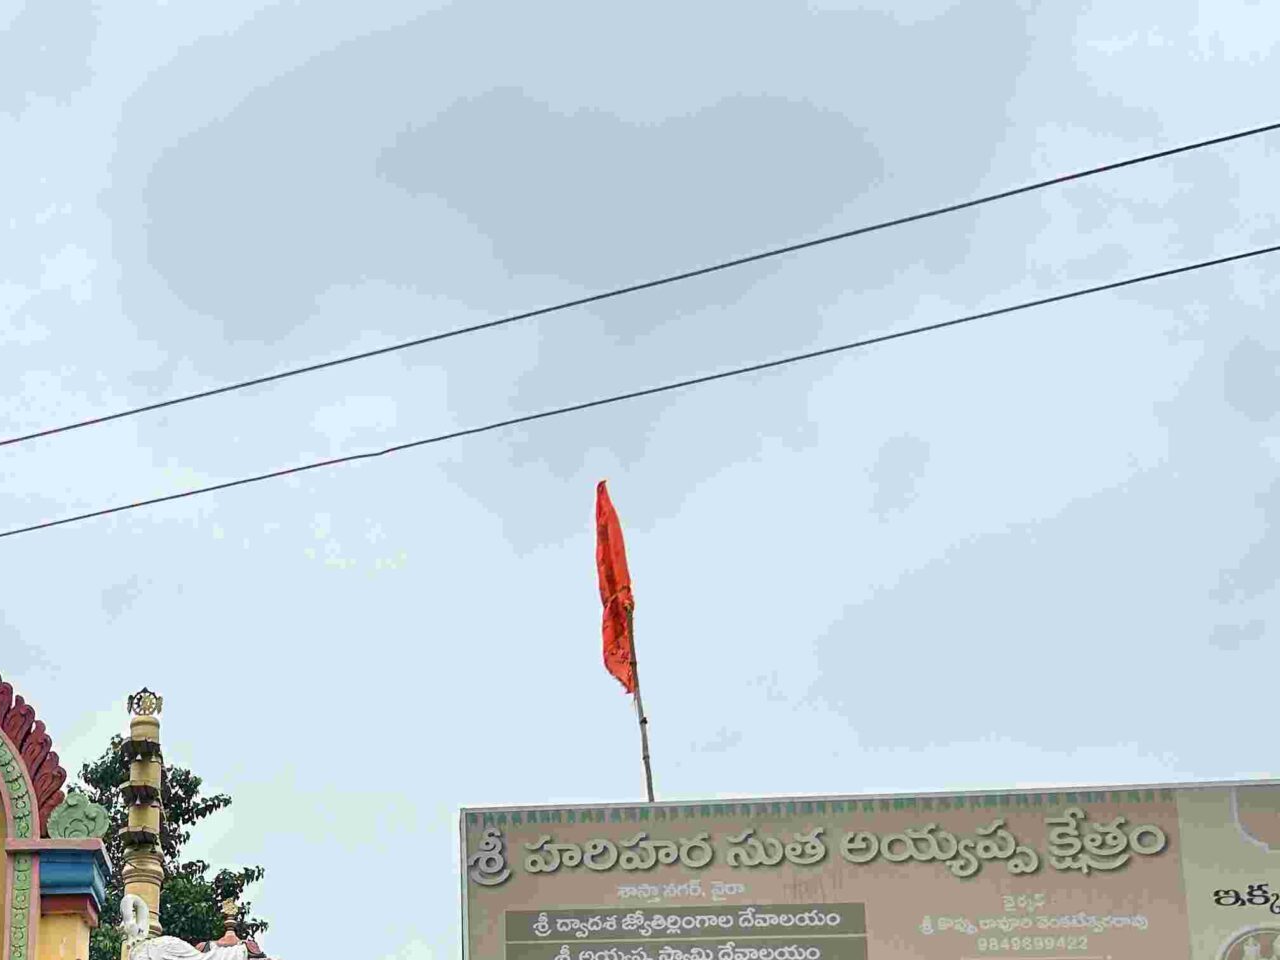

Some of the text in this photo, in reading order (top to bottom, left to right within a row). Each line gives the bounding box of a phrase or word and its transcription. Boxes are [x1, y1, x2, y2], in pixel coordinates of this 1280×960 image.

[468, 806, 1168, 887] శ్రీ హరిహర సుత అయ్యప్ప క్షేత్రం
[532, 907, 841, 938] శ్రీ ద్వాదశ జ్యోతిర్లింగాల దేవాలయం
